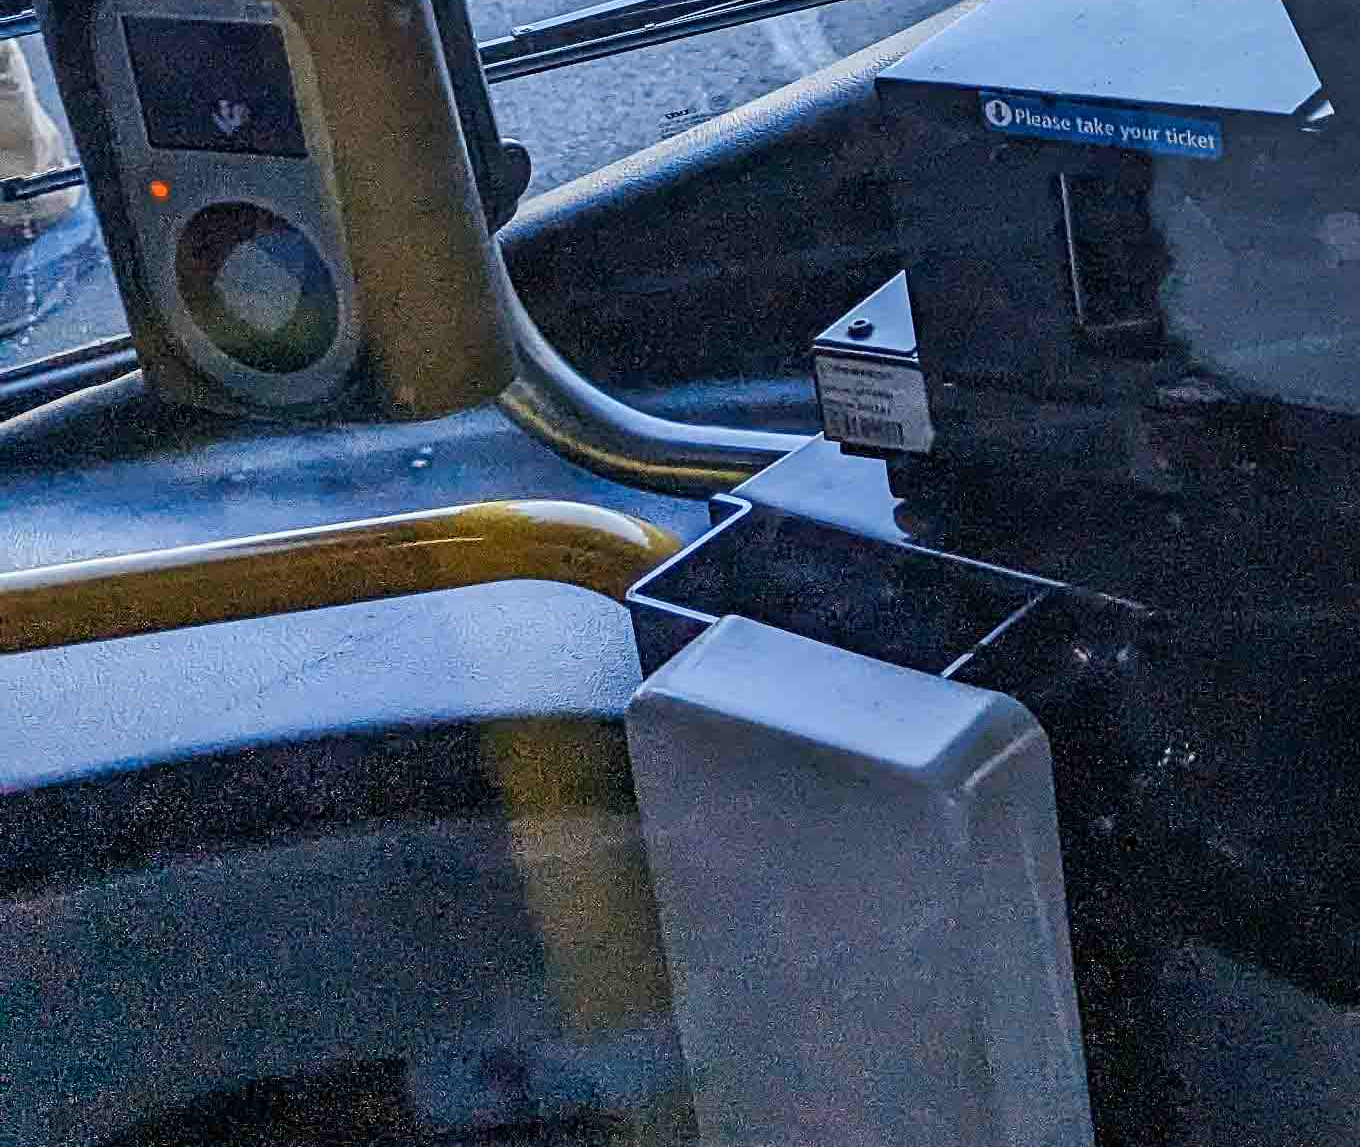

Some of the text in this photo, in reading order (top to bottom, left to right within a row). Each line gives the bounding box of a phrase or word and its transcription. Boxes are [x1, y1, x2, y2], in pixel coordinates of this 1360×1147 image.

[1014, 108, 1216, 150] Please take your ticket
